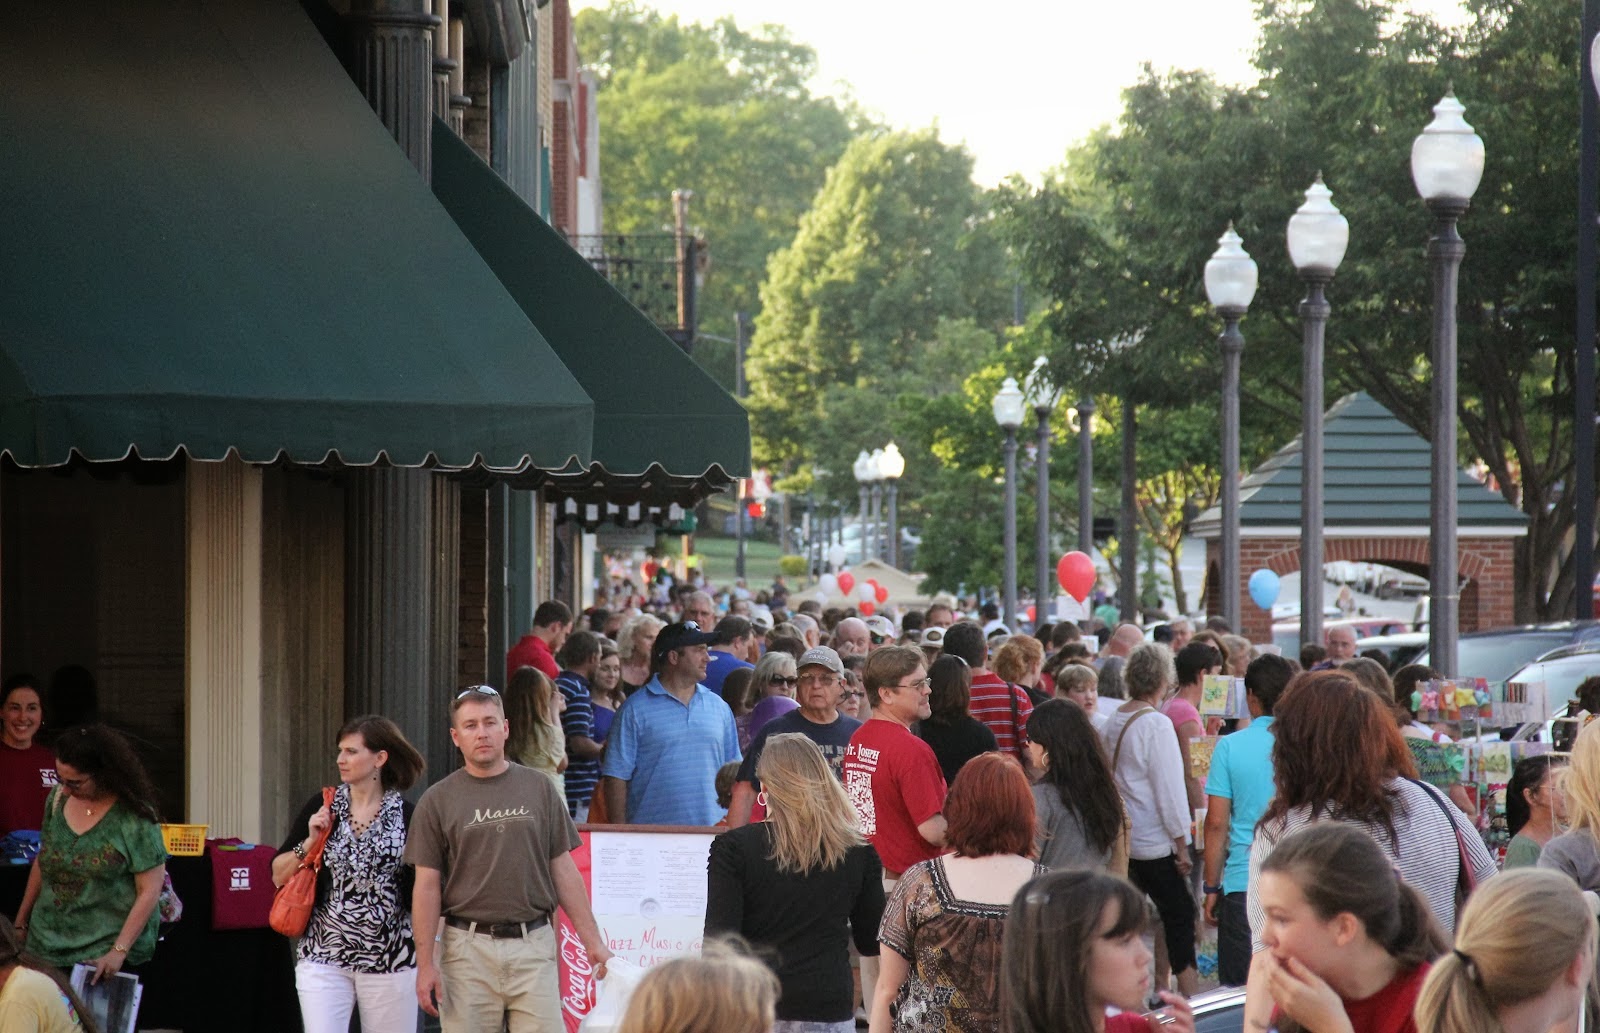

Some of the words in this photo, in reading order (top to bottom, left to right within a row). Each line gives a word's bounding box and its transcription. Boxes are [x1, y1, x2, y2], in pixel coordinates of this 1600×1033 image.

[468, 805, 530, 825] Maui
[640, 926, 682, 951] Music
[560, 922, 593, 1020] Coca-Col
